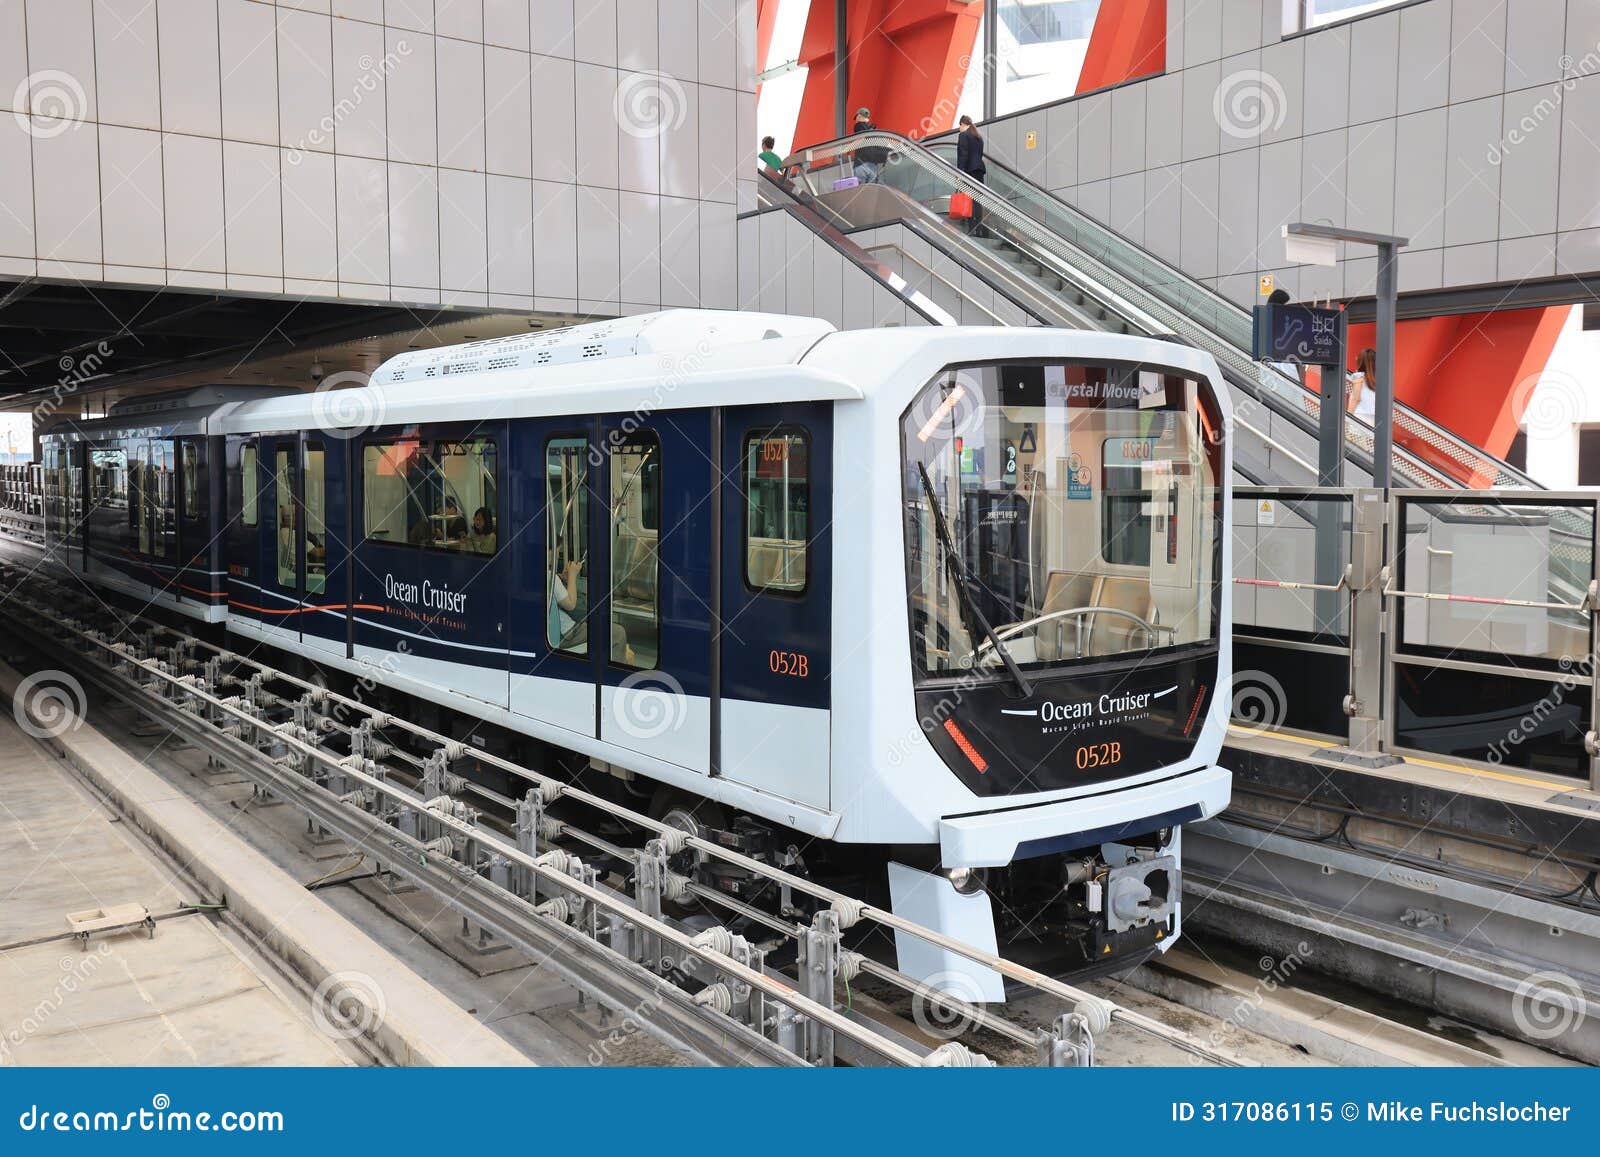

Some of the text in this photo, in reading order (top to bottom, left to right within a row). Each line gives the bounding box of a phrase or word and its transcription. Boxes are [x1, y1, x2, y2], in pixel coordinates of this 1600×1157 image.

[1312, 313, 1334, 333] 出口
[1046, 381, 1143, 400] Crystal Mover
[385, 573, 467, 614] Ocean Cruiser
[770, 650, 809, 677] 052B
[1041, 691, 1151, 722] Ocean Cruiser
[1042, 712, 1150, 734] Macau Light Rapid Transit
[1075, 741, 1121, 769] 052B
